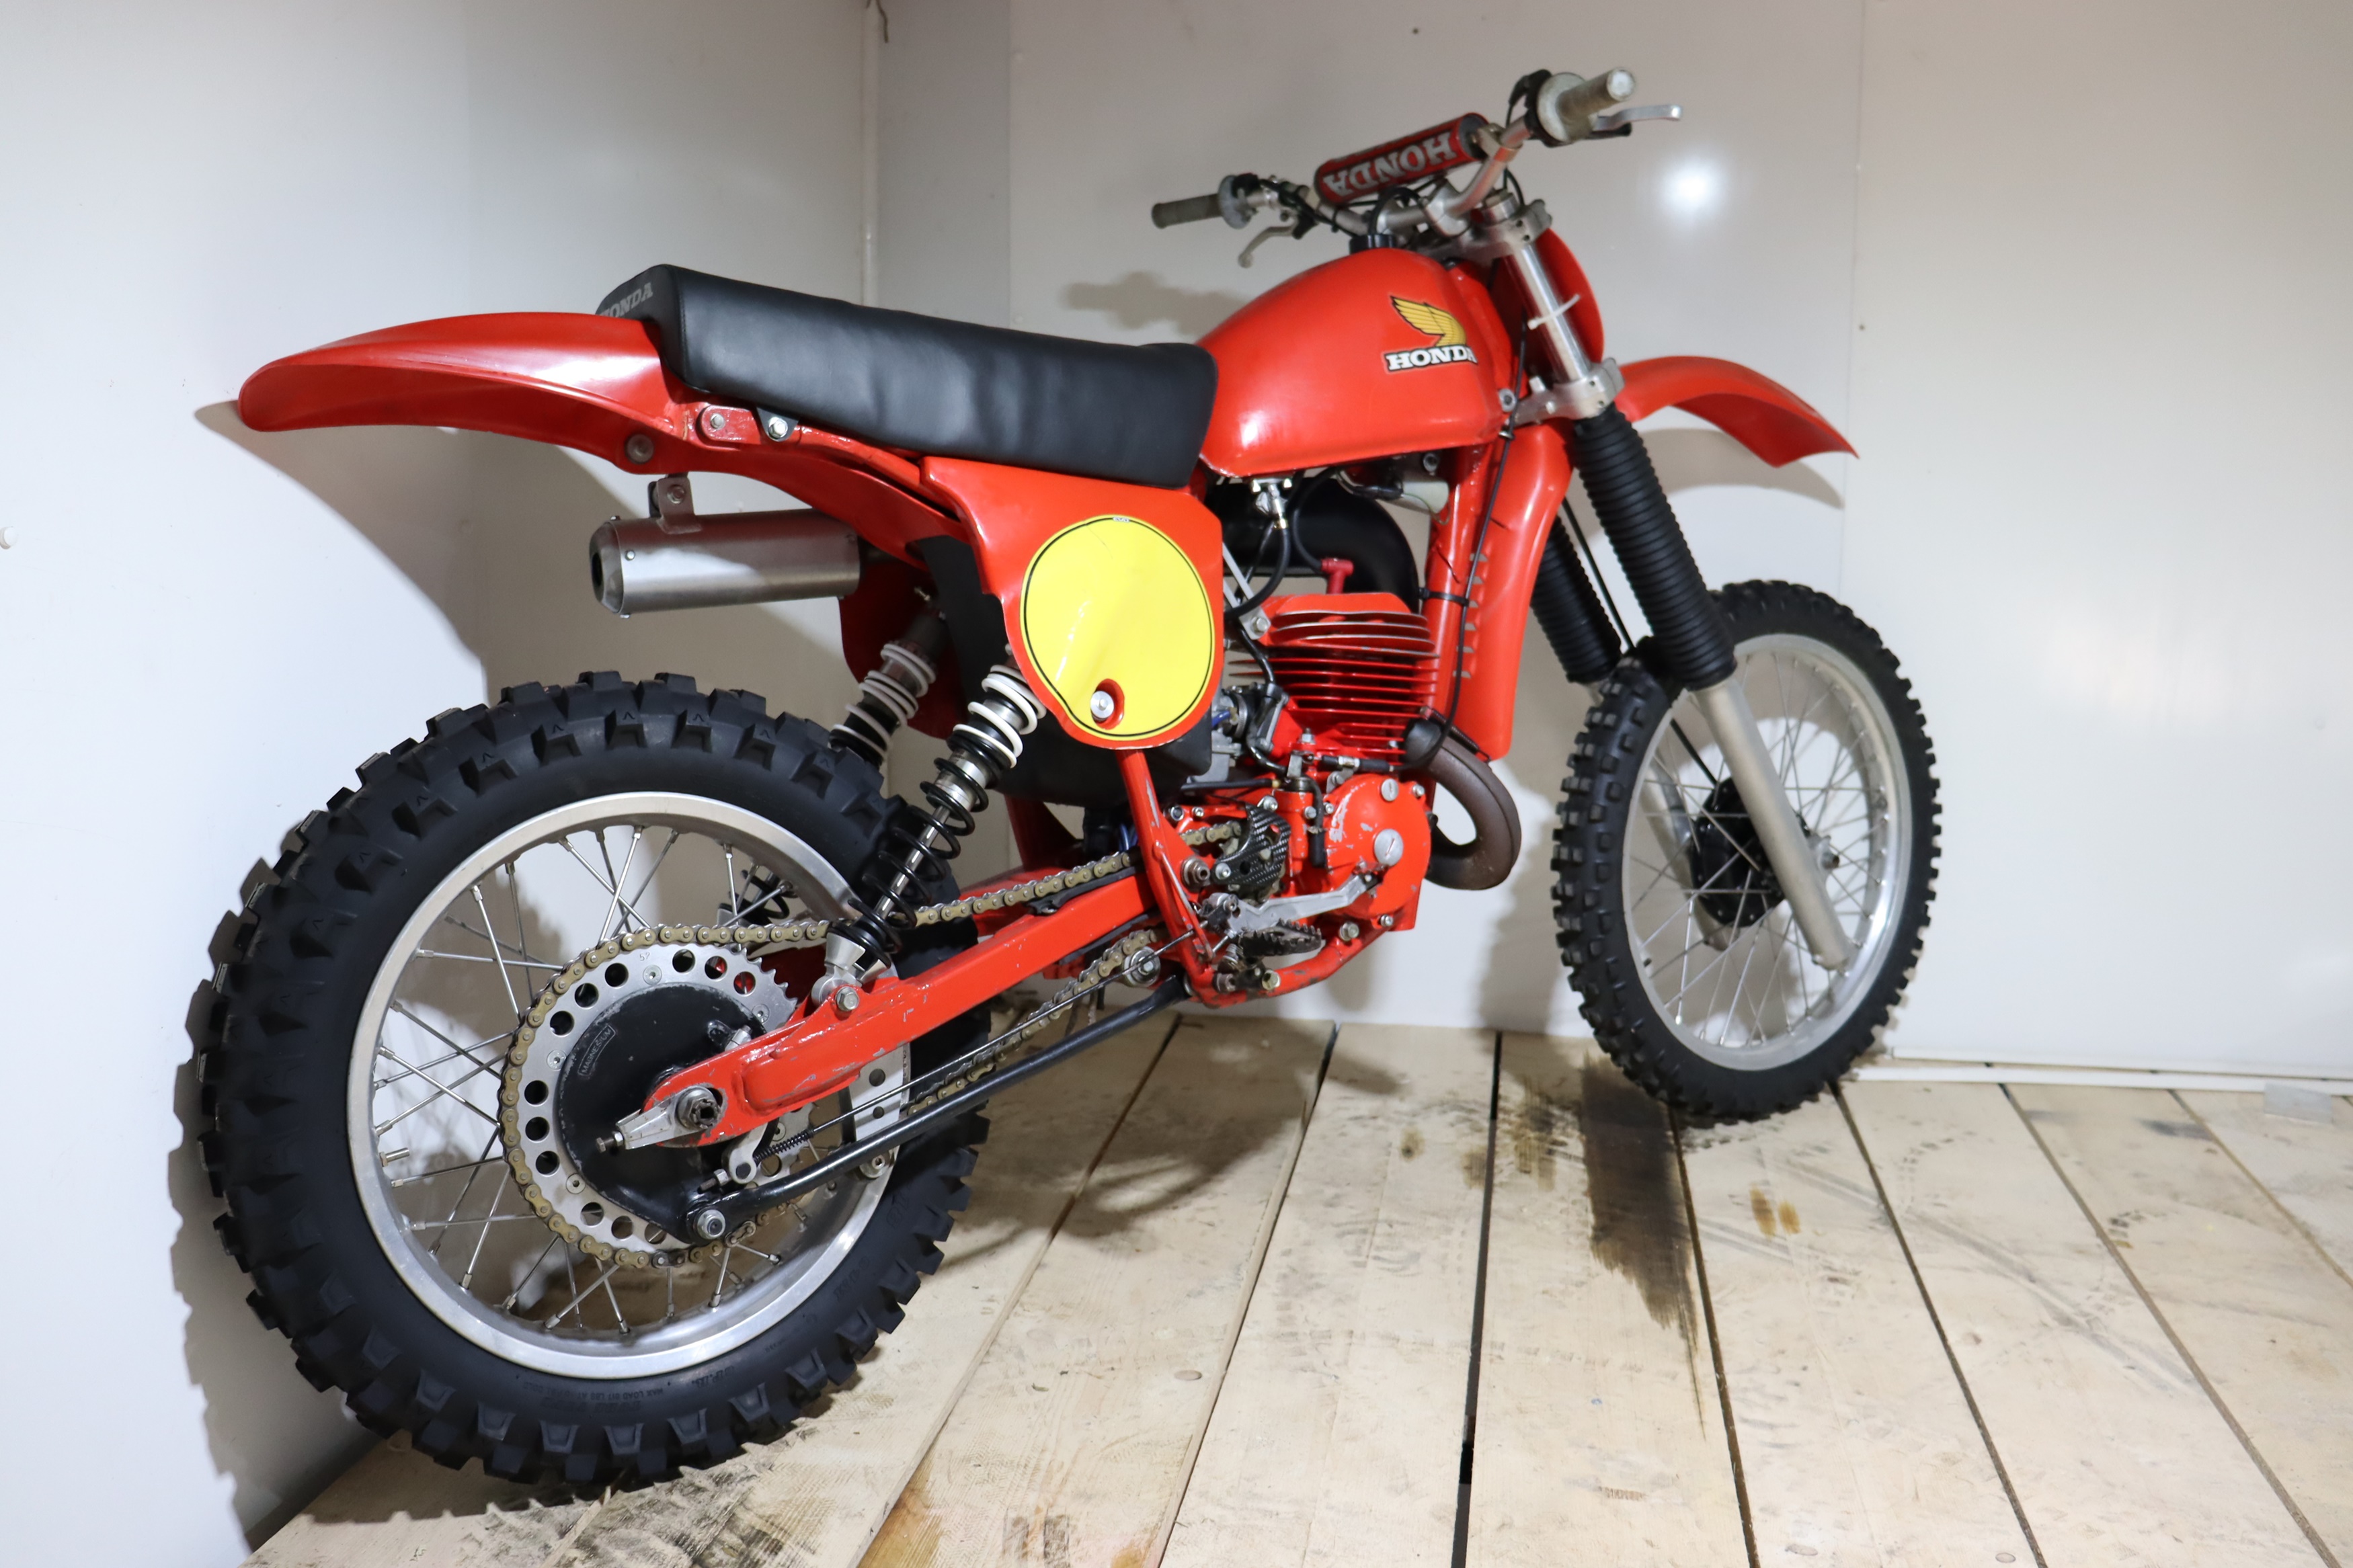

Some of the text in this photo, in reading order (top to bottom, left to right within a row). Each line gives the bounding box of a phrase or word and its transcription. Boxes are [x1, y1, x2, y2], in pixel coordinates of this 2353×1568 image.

[1322, 131, 1458, 196] HONDA
[1385, 344, 1478, 372] HONDA
[581, 1028, 612, 1073] MAGNESIUM
[623, 1391, 644, 1399] LOAD
